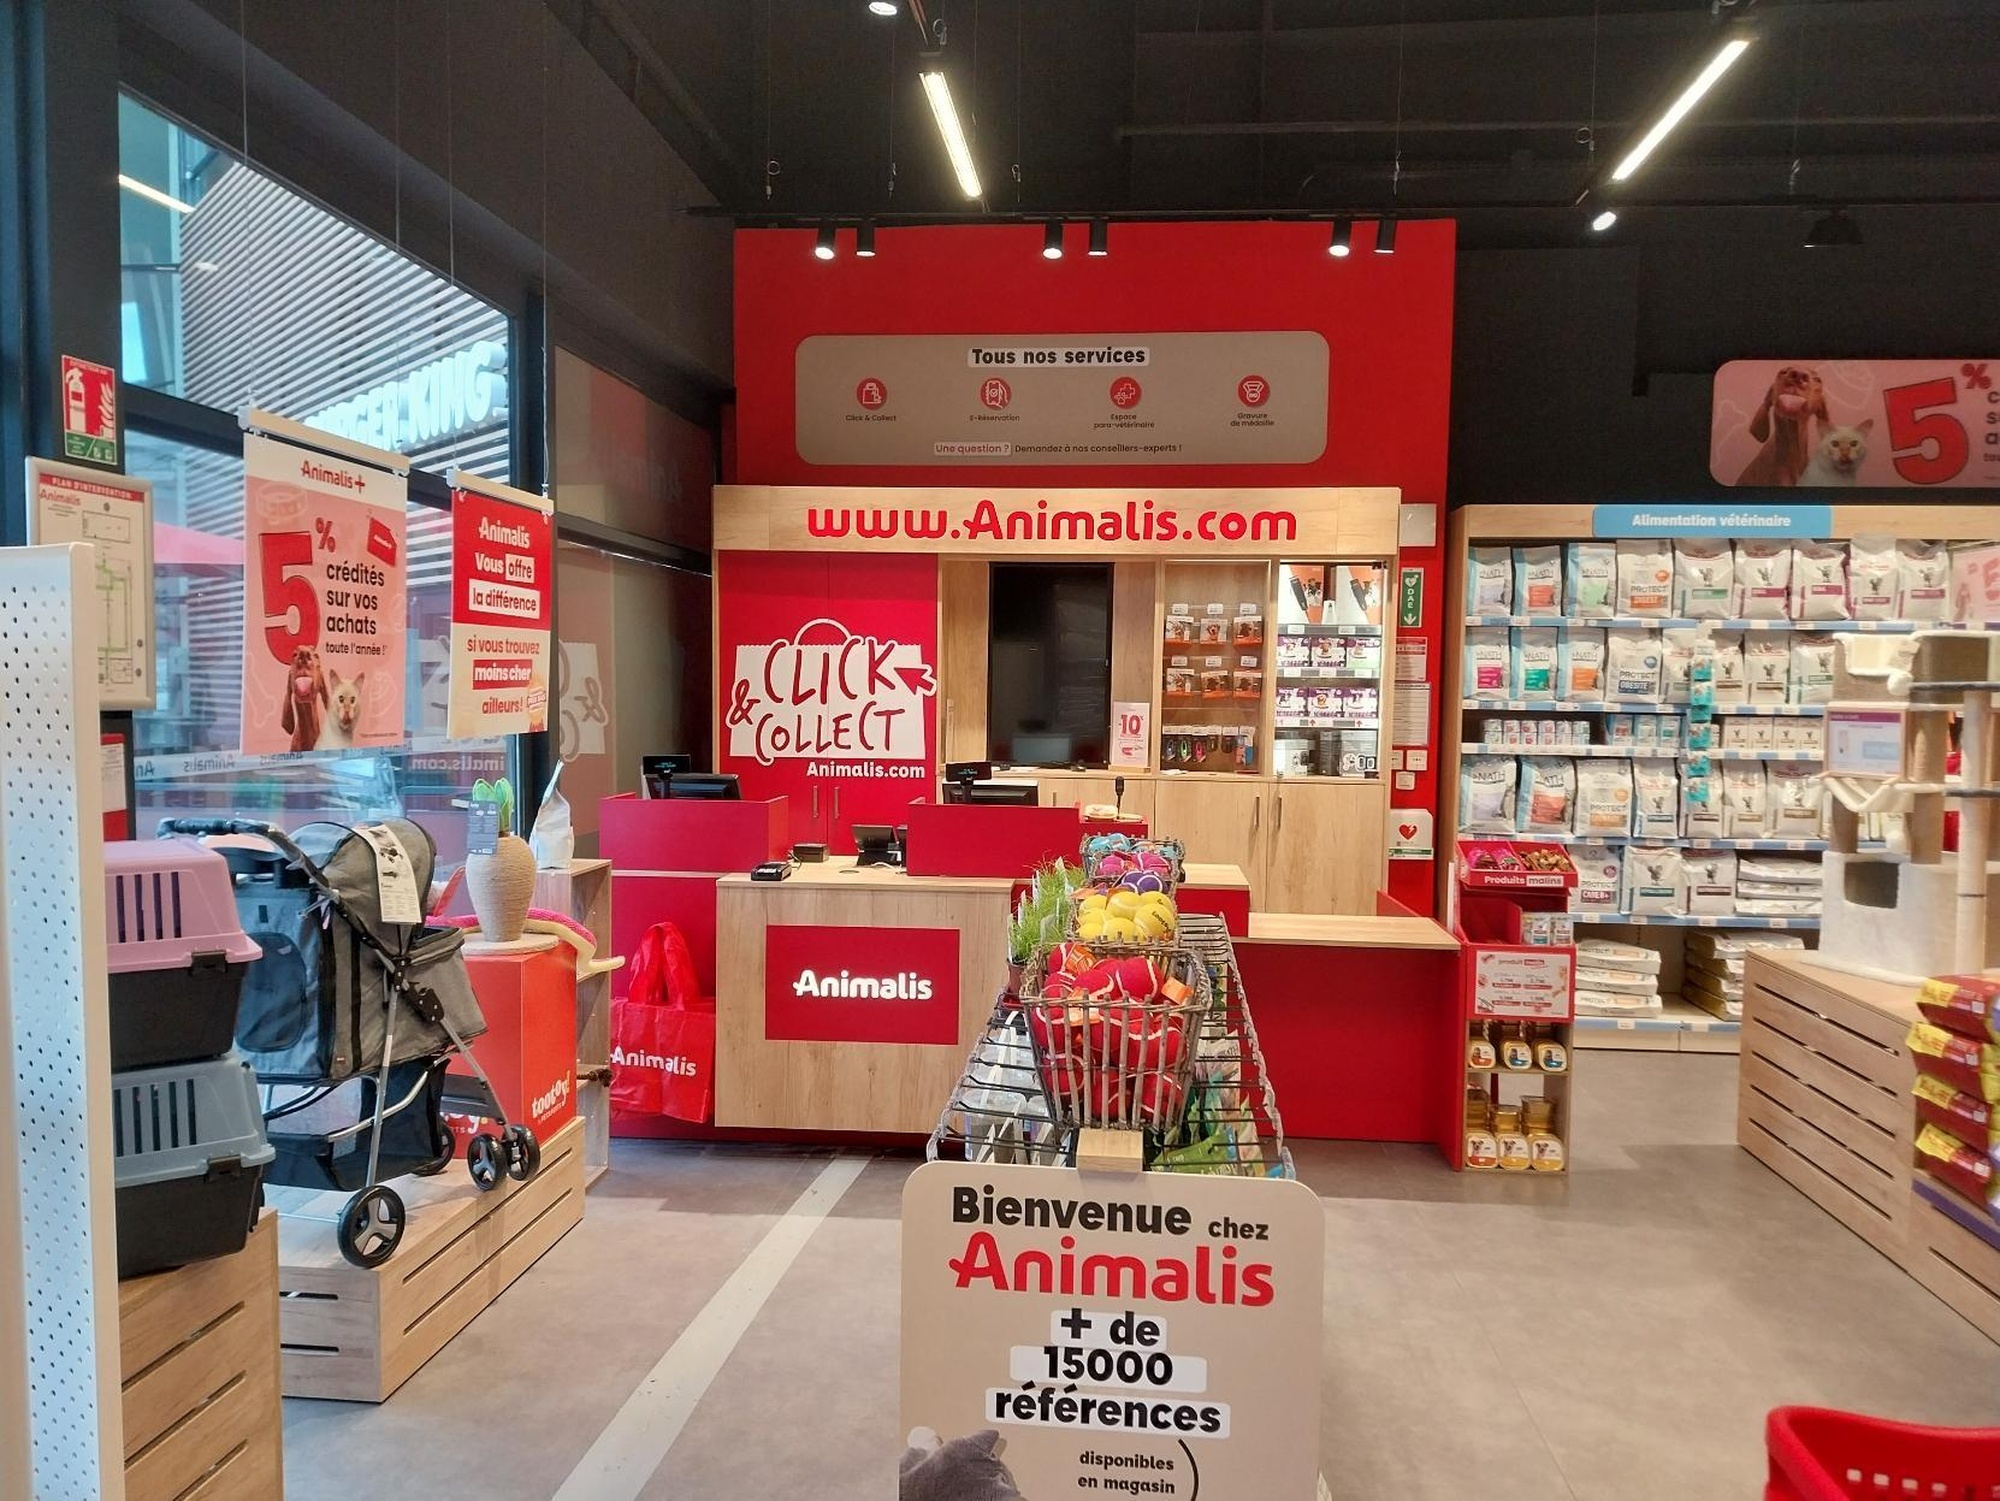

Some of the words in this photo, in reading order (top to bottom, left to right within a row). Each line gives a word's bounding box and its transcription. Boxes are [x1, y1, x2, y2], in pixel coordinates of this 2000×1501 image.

[971, 348, 1016, 365] Tous
[1023, 350, 1057, 364] nos
[1064, 346, 1146, 364] services
[409, 340, 508, 443] KING
[845, 414, 863, 422] Click
[864, 414, 871, 422] &
[872, 414, 897, 422] Collect
[969, 413, 1021, 422] E-Réservation
[1093, 421, 1155, 429] para-vétérinaire
[1110, 413, 1137, 422] Espace
[1230, 419, 1241, 427] de
[1242, 419, 1275, 427] médaille
[1237, 412, 1268, 420] Gravure
[935, 444, 957, 453] Une
[958, 443, 1002, 455] question
[1003, 444, 1010, 453] ?
[1015, 444, 1063, 453] Demandez
[1064, 443, 1071, 453] à
[1090, 443, 1177, 454] conseillers-experts
[52, 477, 72, 489] PLAN
[807, 499, 1296, 541] www.Animalis.com
[1632, 514, 1716, 528] Alimentation
[1720, 514, 1791, 528] vétérinaire
[478, 516, 530, 549] Animalis
[326, 561, 385, 587] crédités
[475, 552, 504, 574] Vous
[508, 557, 533, 579] offre
[326, 589, 351, 607] sur
[353, 593, 378, 611] vos
[473, 587, 484, 606] la
[485, 587, 537, 612] différence
[326, 613, 377, 635] achats
[326, 642, 349, 655] toute
[350, 641, 381, 656] l'année
[467, 634, 477, 653] si
[478, 640, 504, 653] vous
[505, 638, 540, 655] trouvez
[475, 662, 509, 681] moins
[509, 664, 531, 681] cher
[764, 638, 897, 706] CLICK
[729, 678, 761, 726] &
[755, 700, 906, 763] COLLECT
[806, 761, 925, 778] Animalis.com
[1485, 875, 1526, 884] Produits
[1528, 876, 1562, 885] malins
[793, 969, 933, 1001] Animalis
[610, 1045, 696, 1077] Animalis
[952, 1184, 1192, 1235] Bienvenue
[1208, 1217, 1270, 1241] chez
[948, 1231, 1275, 1308] Animalis
[1060, 1307, 1092, 1340] +
[1109, 1310, 1161, 1347] de
[1043, 1345, 1174, 1386] 15000
[994, 1380, 1222, 1434] références
[1079, 1450, 1175, 1472] disponibles
[1077, 1475, 1098, 1489] en
[1103, 1474, 1176, 1496] magasin
